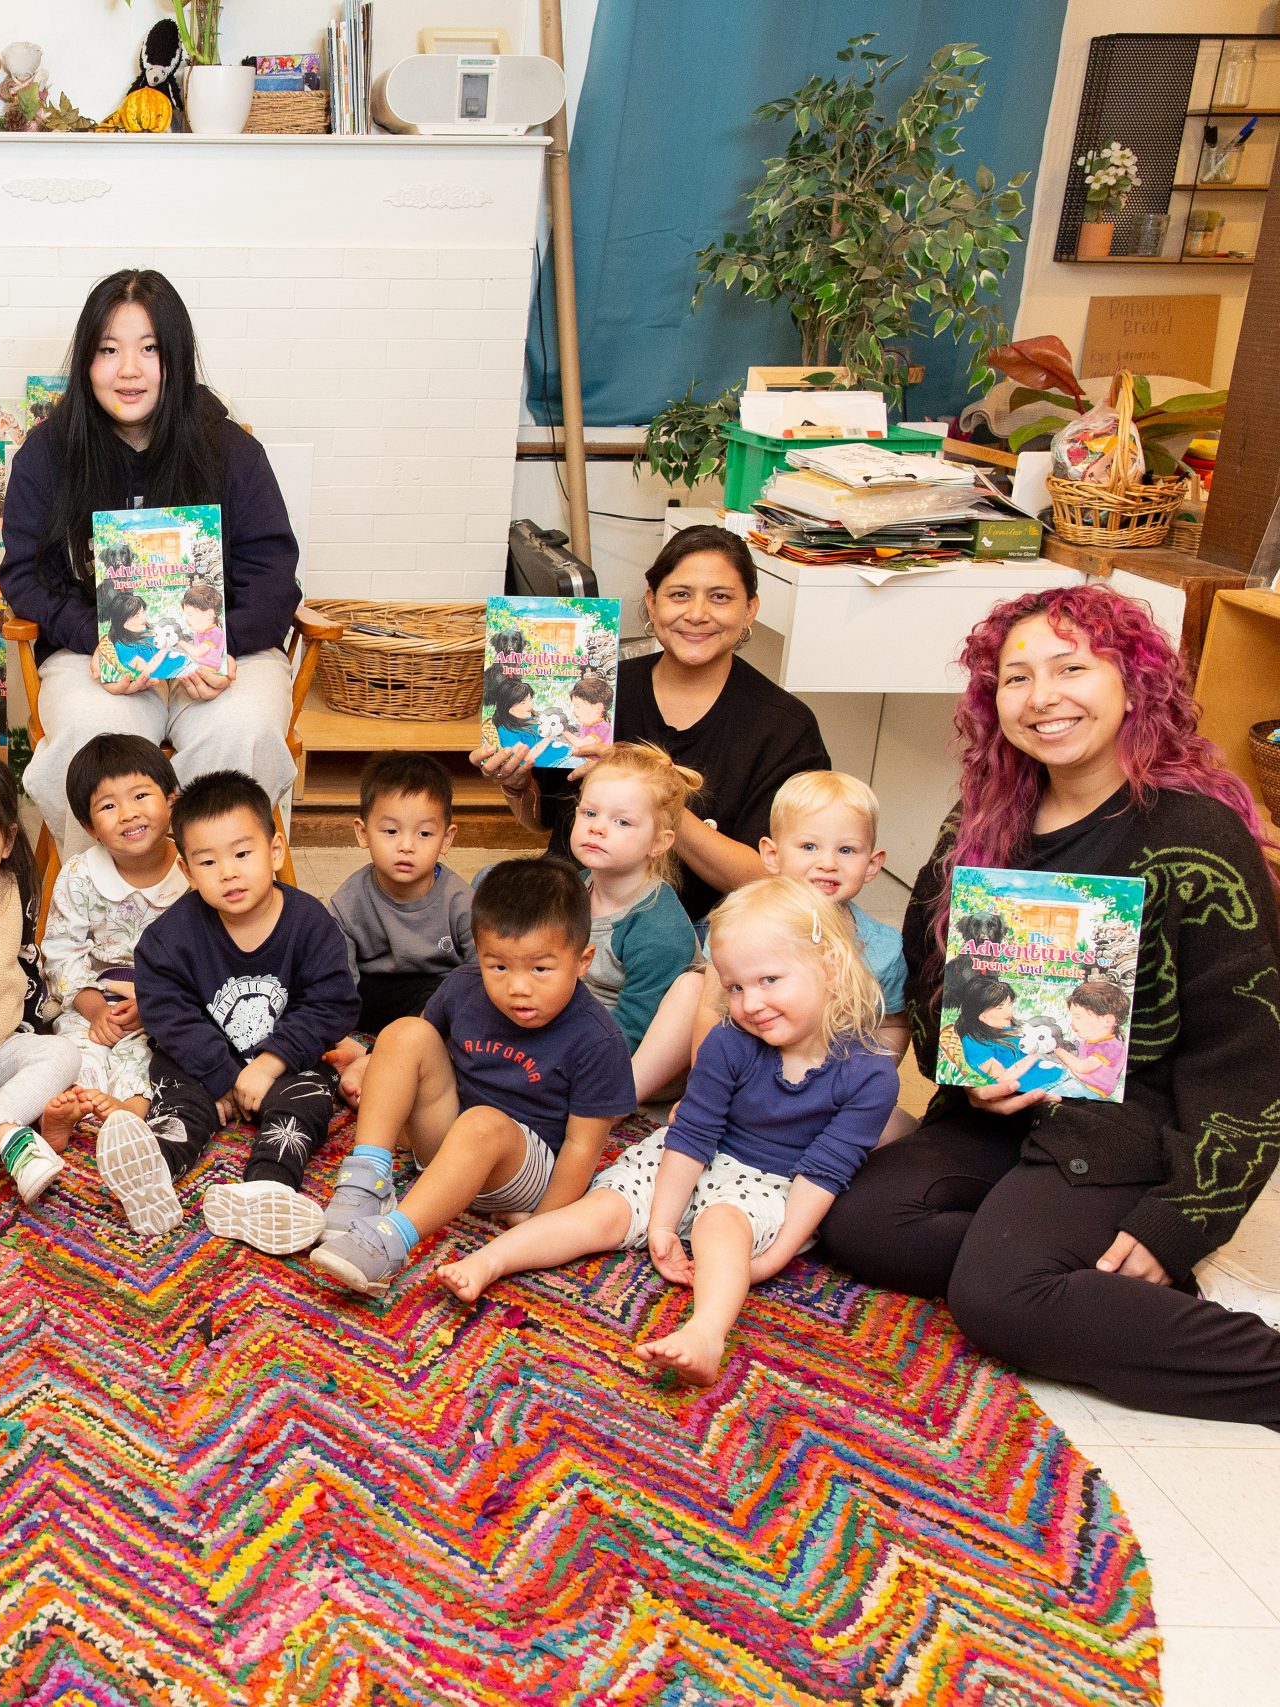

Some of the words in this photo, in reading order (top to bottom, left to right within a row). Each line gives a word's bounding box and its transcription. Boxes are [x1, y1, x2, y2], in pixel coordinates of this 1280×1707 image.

[105, 562, 196, 579] Adventures
[493, 651, 589, 667] Adventures
[1029, 932, 1054, 944] The
[959, 939, 1096, 965] Adventures
[972, 958, 1012, 972] Irene
[1015, 963, 1042, 975] And
[1046, 967, 1086, 979] Adele
[464, 1039, 542, 1083] ALIFORNIA
